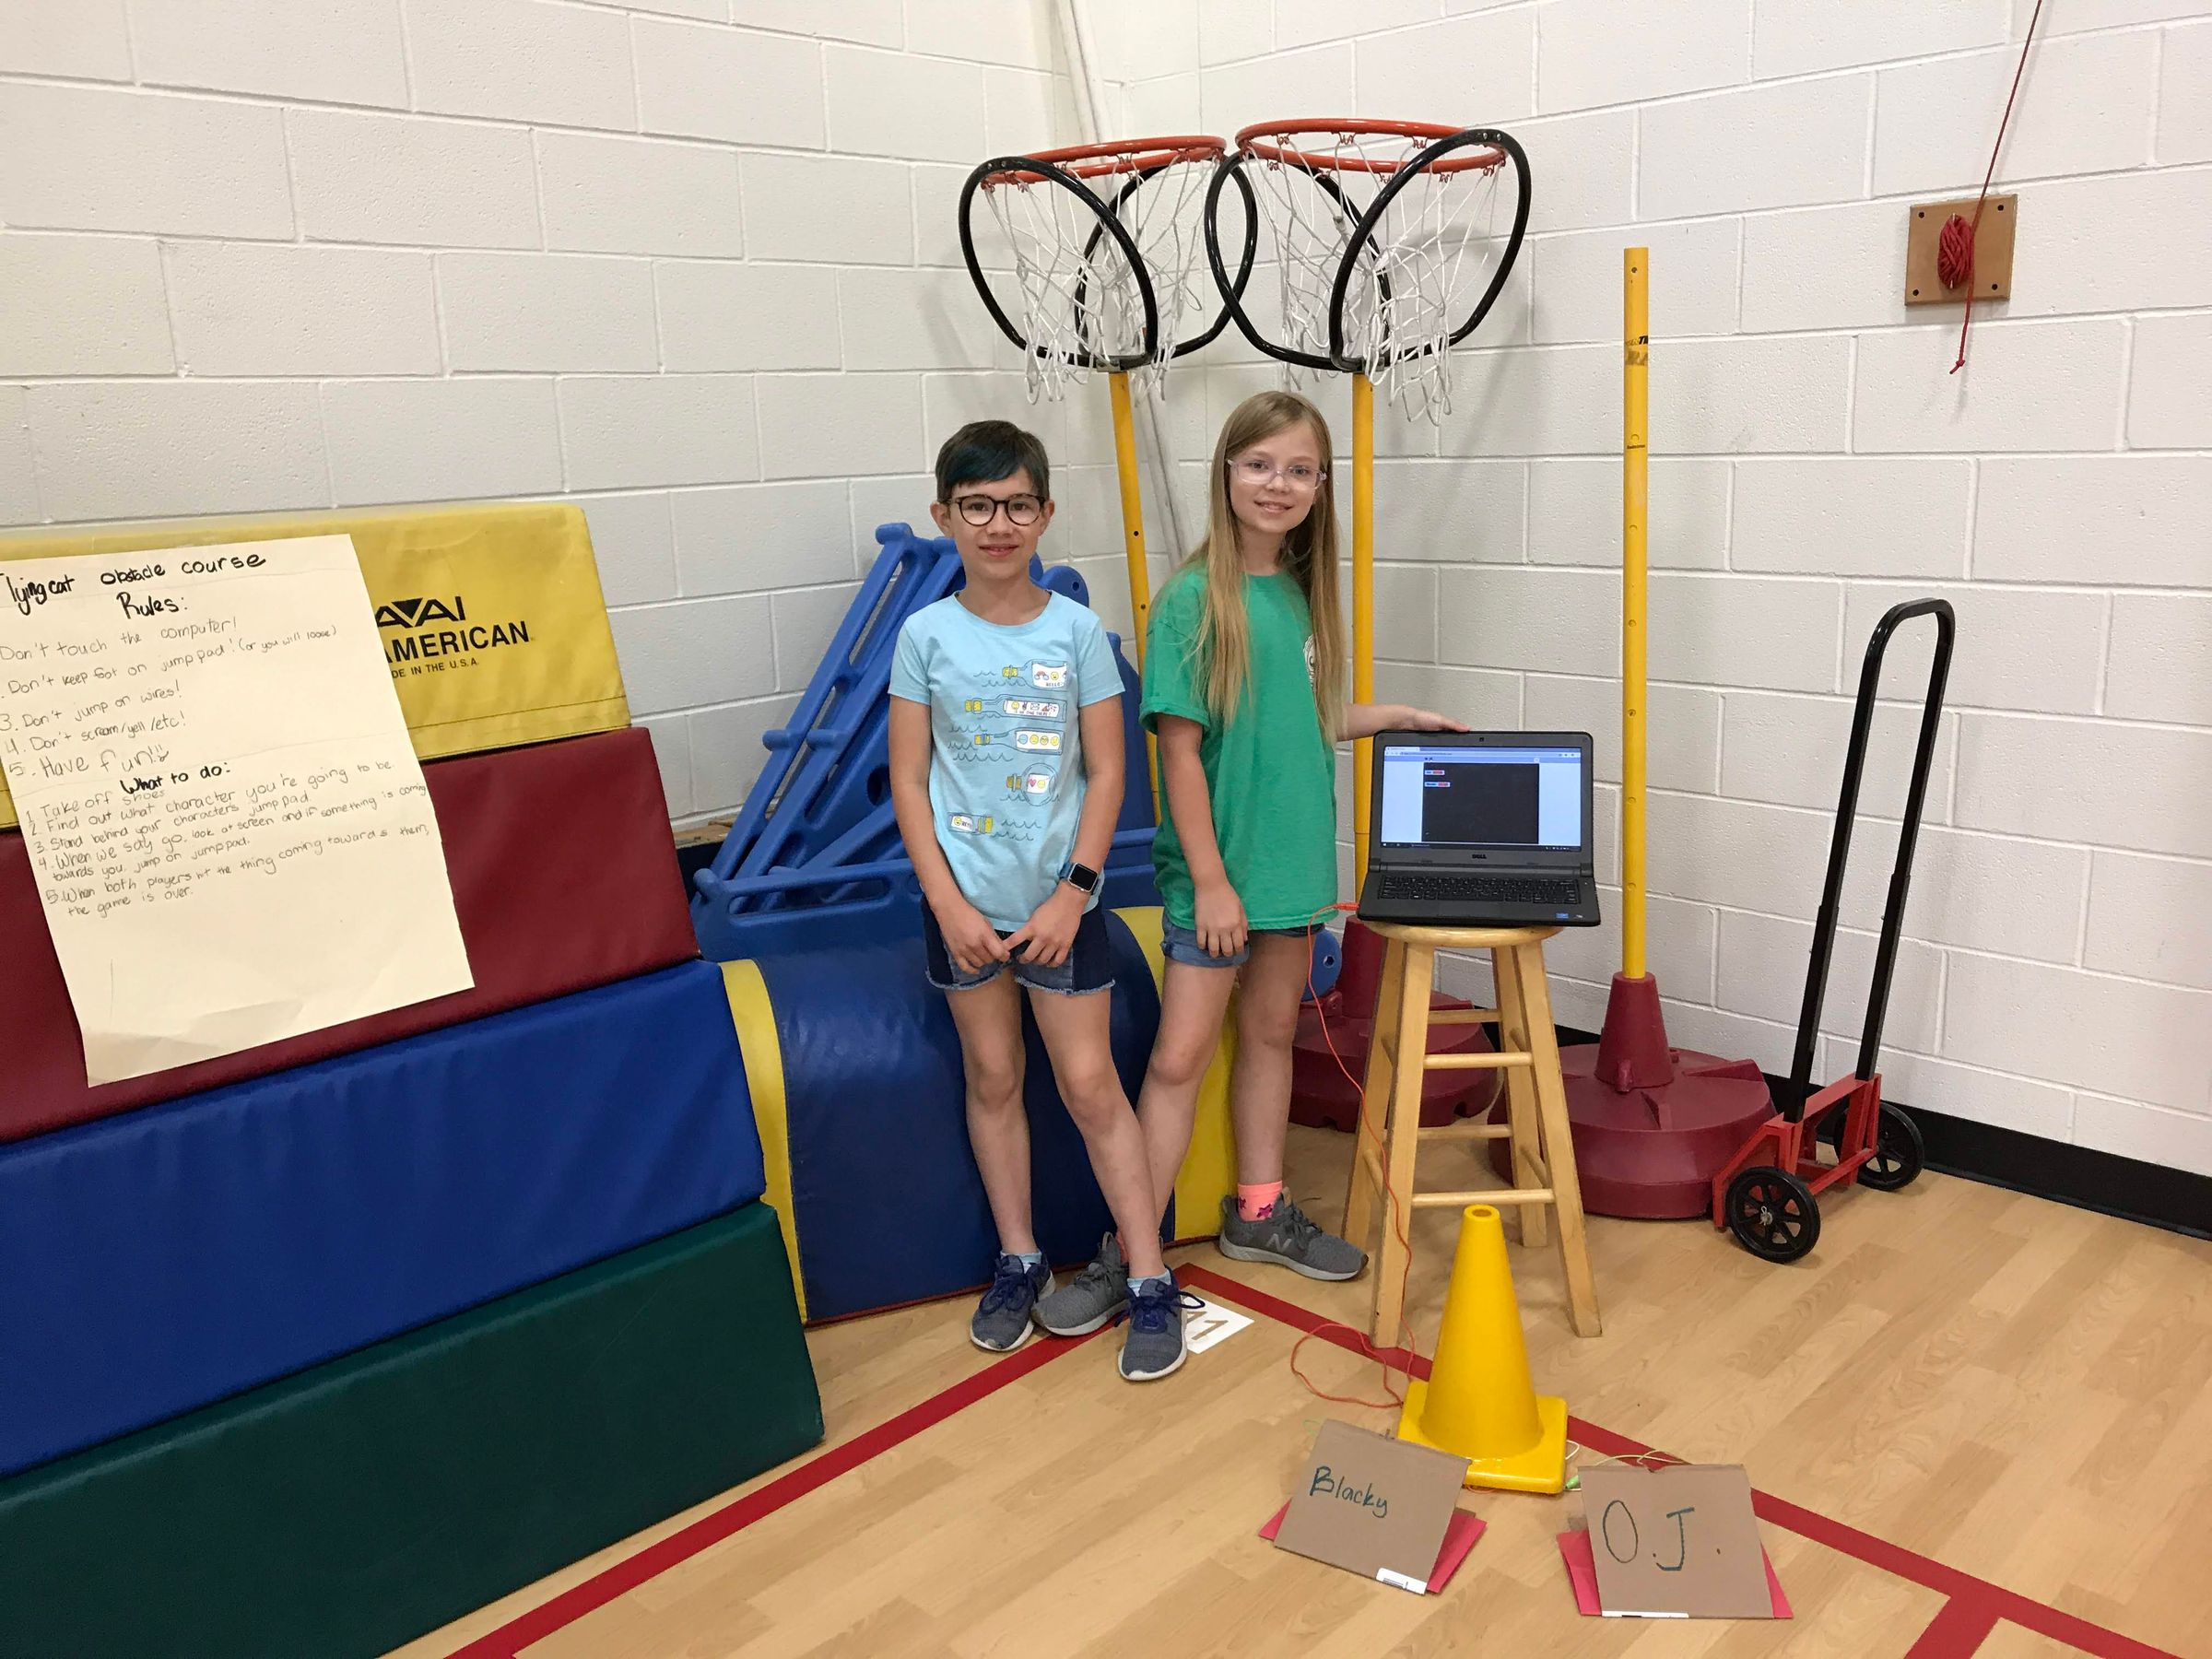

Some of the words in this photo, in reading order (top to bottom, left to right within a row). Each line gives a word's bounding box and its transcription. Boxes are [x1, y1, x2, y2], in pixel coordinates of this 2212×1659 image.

[0, 572, 48, 616] lying
[179, 553, 266, 574] course
[116, 591, 188, 619] Rules:
[0, 642, 49, 660] Don't
[56, 638, 108, 657] touch
[120, 631, 142, 646] the
[160, 616, 237, 640] computer!
[7, 674, 54, 694] Don't
[63, 671, 88, 687] keep
[127, 663, 147, 677] on
[262, 640, 279, 653] you
[282, 632, 300, 646] will
[392, 669, 406, 679] DE
[411, 665, 422, 676] IN
[426, 662, 445, 673] THE
[22, 709, 62, 726] Don't
[75, 701, 108, 722] jump
[115, 696, 131, 708] on
[140, 679, 182, 703] wires!
[29, 731, 71, 751] Don't
[9, 762, 36, 777] 5.
[39, 757, 88, 778] Have
[120, 775, 163, 794] What
[171, 772, 189, 783] to
[200, 762, 230, 780] do:
[40, 800, 80, 818] Take
[85, 791, 113, 808] off
[122, 789, 166, 806] shoes
[46, 817, 79, 832] Find
[88, 812, 112, 826] out
[246, 773, 298, 803] you're
[308, 767, 348, 789] going
[358, 764, 371, 773] to
[50, 836, 84, 851] Stand
[90, 827, 129, 844] behind
[135, 819, 162, 838] your
[173, 804, 239, 827] characters
[249, 799, 279, 818] jump
[55, 851, 91, 871] When
[96, 847, 118, 862] we
[123, 834, 153, 855] say
[192, 828, 214, 840] look
[221, 824, 233, 834] at
[237, 818, 275, 830] screen
[281, 808, 302, 822] and
[305, 806, 318, 818] if
[321, 796, 378, 818] something
[382, 790, 394, 799] is
[104, 877, 137, 893] both
[147, 873, 192, 889] players
[217, 865, 231, 875] the
[240, 855, 276, 875] thing
[278, 839, 323, 861] coming
[327, 830, 388, 844] towards
[134, 856, 160, 873] jump
[166, 853, 182, 863] on
[67, 904, 90, 916] the
[97, 897, 132, 918] game
[142, 890, 155, 902] is
[1309, 1465, 1387, 1519] Blacky
